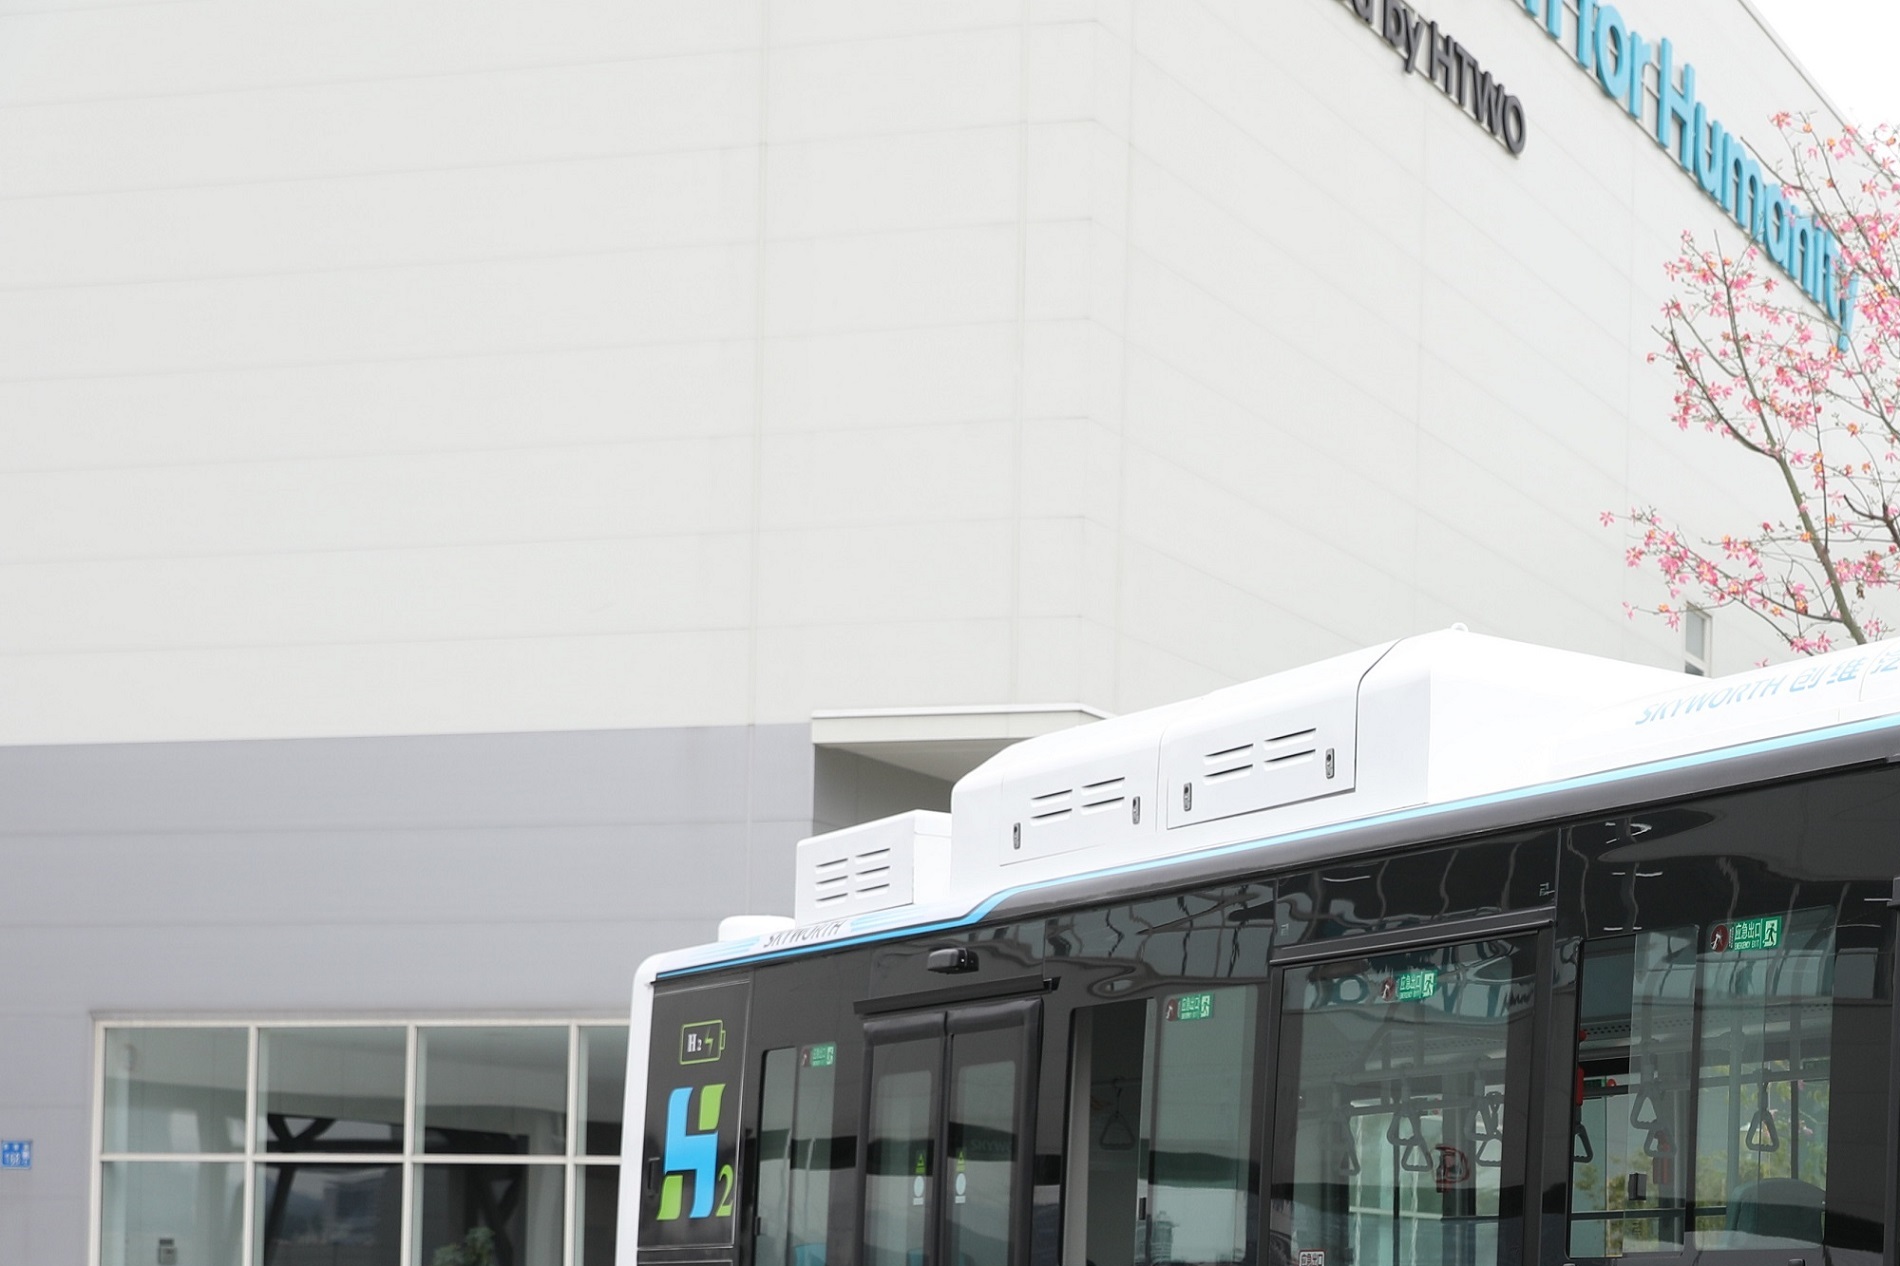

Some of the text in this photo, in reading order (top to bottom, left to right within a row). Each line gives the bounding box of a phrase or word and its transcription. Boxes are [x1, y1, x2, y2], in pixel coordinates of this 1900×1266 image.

[1429, 20, 1527, 155] HTWO
[1657, 37, 1860, 353] Humanity
[1634, 675, 1788, 726] SKYWORTH
